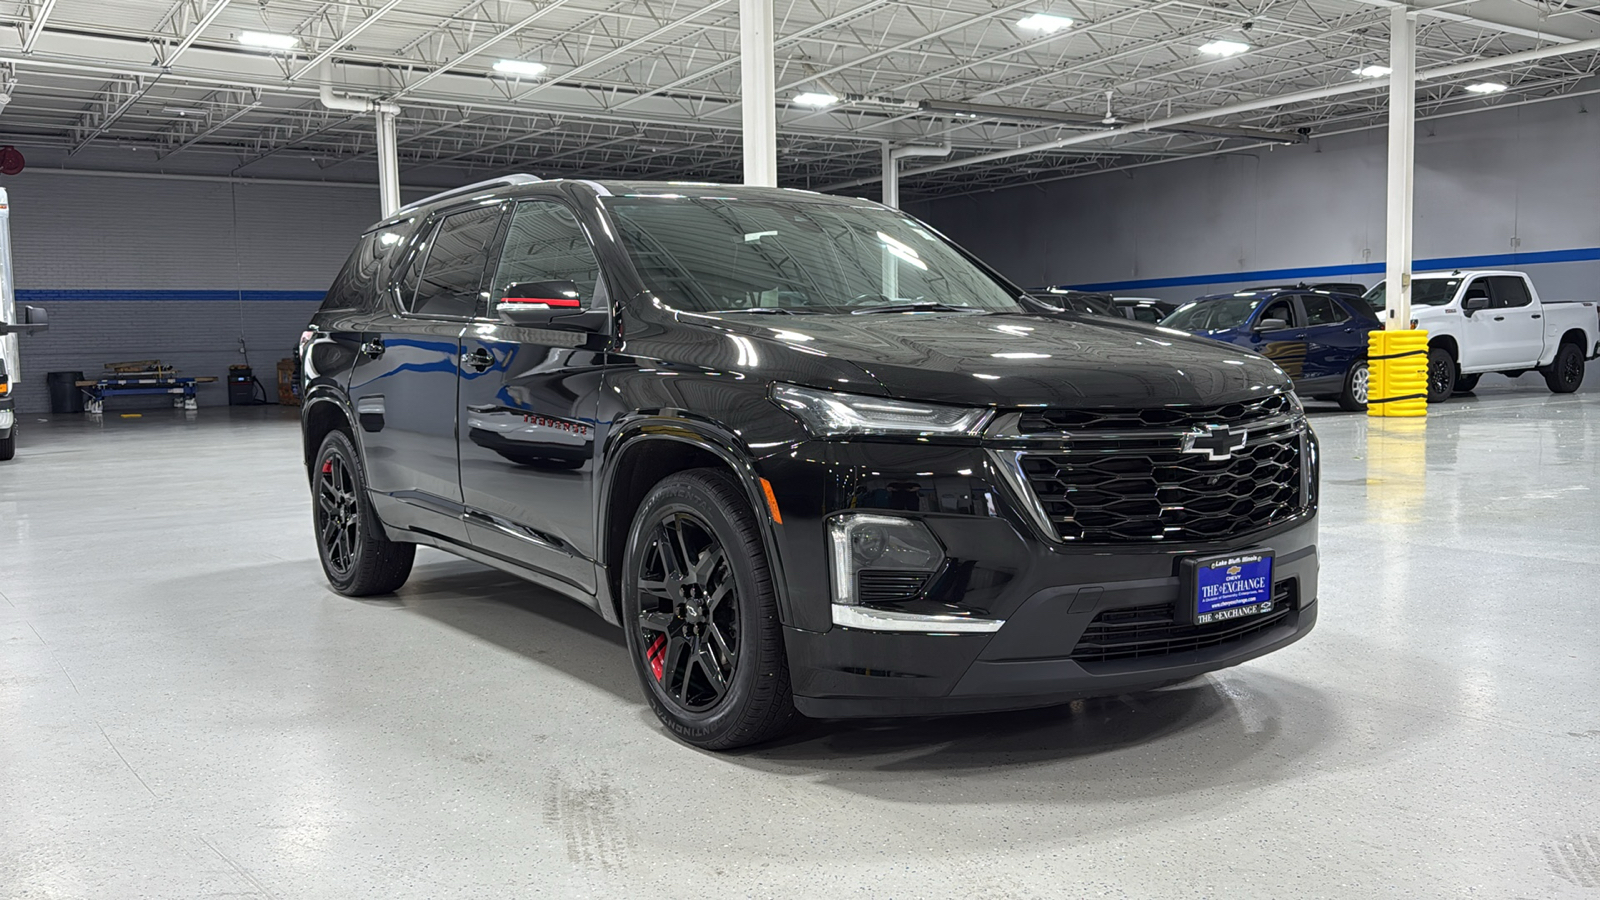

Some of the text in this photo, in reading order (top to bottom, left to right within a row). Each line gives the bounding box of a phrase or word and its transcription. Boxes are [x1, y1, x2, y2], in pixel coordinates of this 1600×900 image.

[1202, 577, 1265, 597] THE EXCHANGE
[1198, 605, 1258, 624] THE EXCHANGE
[650, 698, 727, 737] CONTINENTAL
